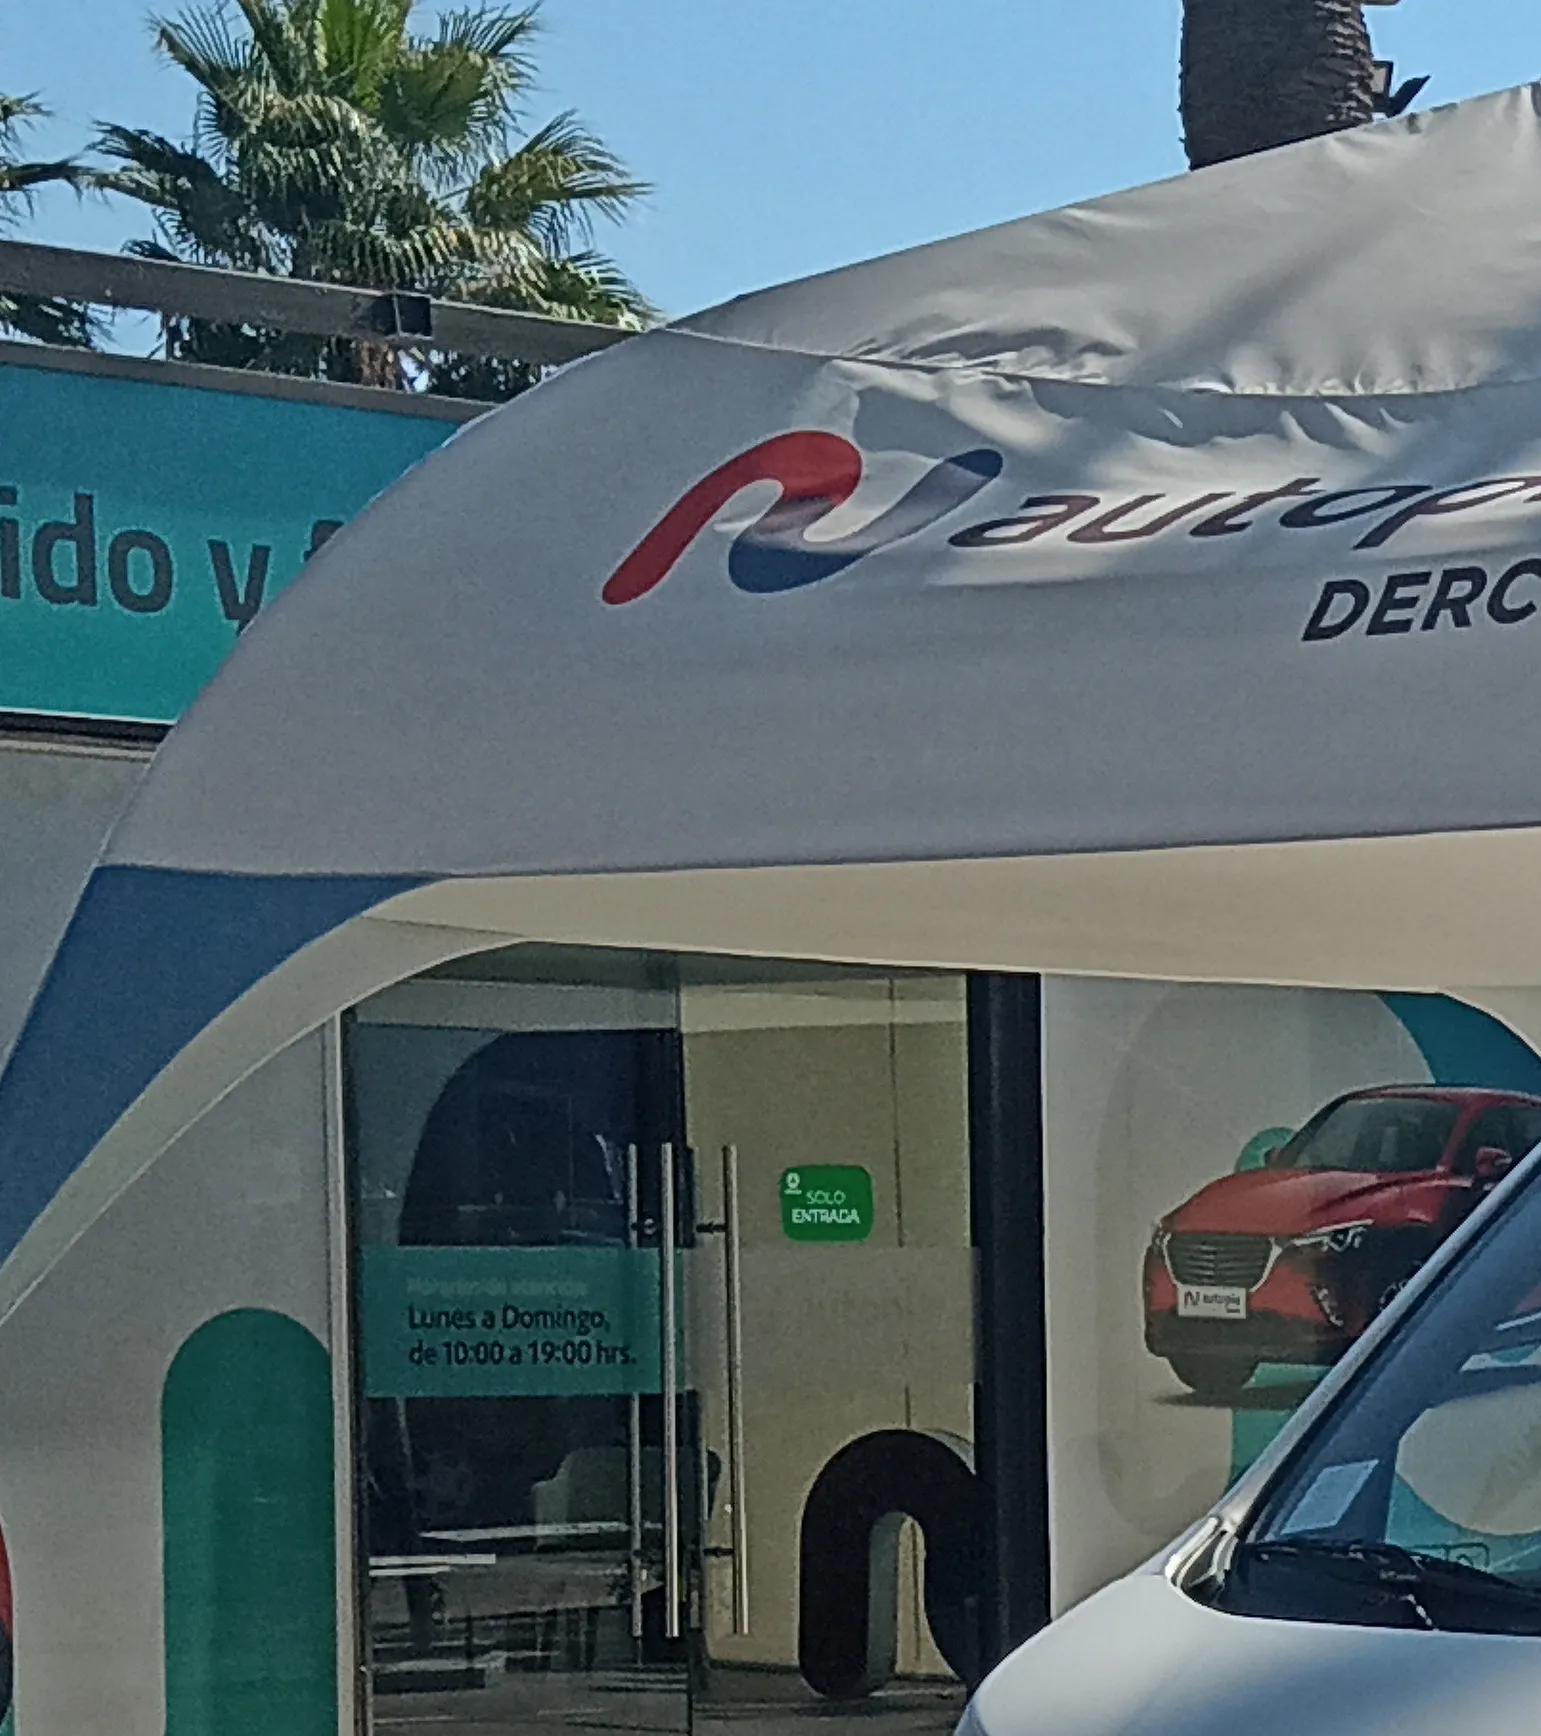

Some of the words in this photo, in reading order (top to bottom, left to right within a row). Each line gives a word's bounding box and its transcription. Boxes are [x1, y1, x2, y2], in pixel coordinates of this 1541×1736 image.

[805, 1190, 846, 1205] SOLO
[791, 1208, 861, 1224] ENTRADA
[408, 1305, 477, 1330] Lunes
[481, 1310, 496, 1330] a
[502, 1304, 611, 1336] Domingo,
[408, 1339, 438, 1366] de
[441, 1340, 504, 1366] 10:00
[508, 1347, 523, 1366] a
[527, 1340, 592, 1366] 19:00
